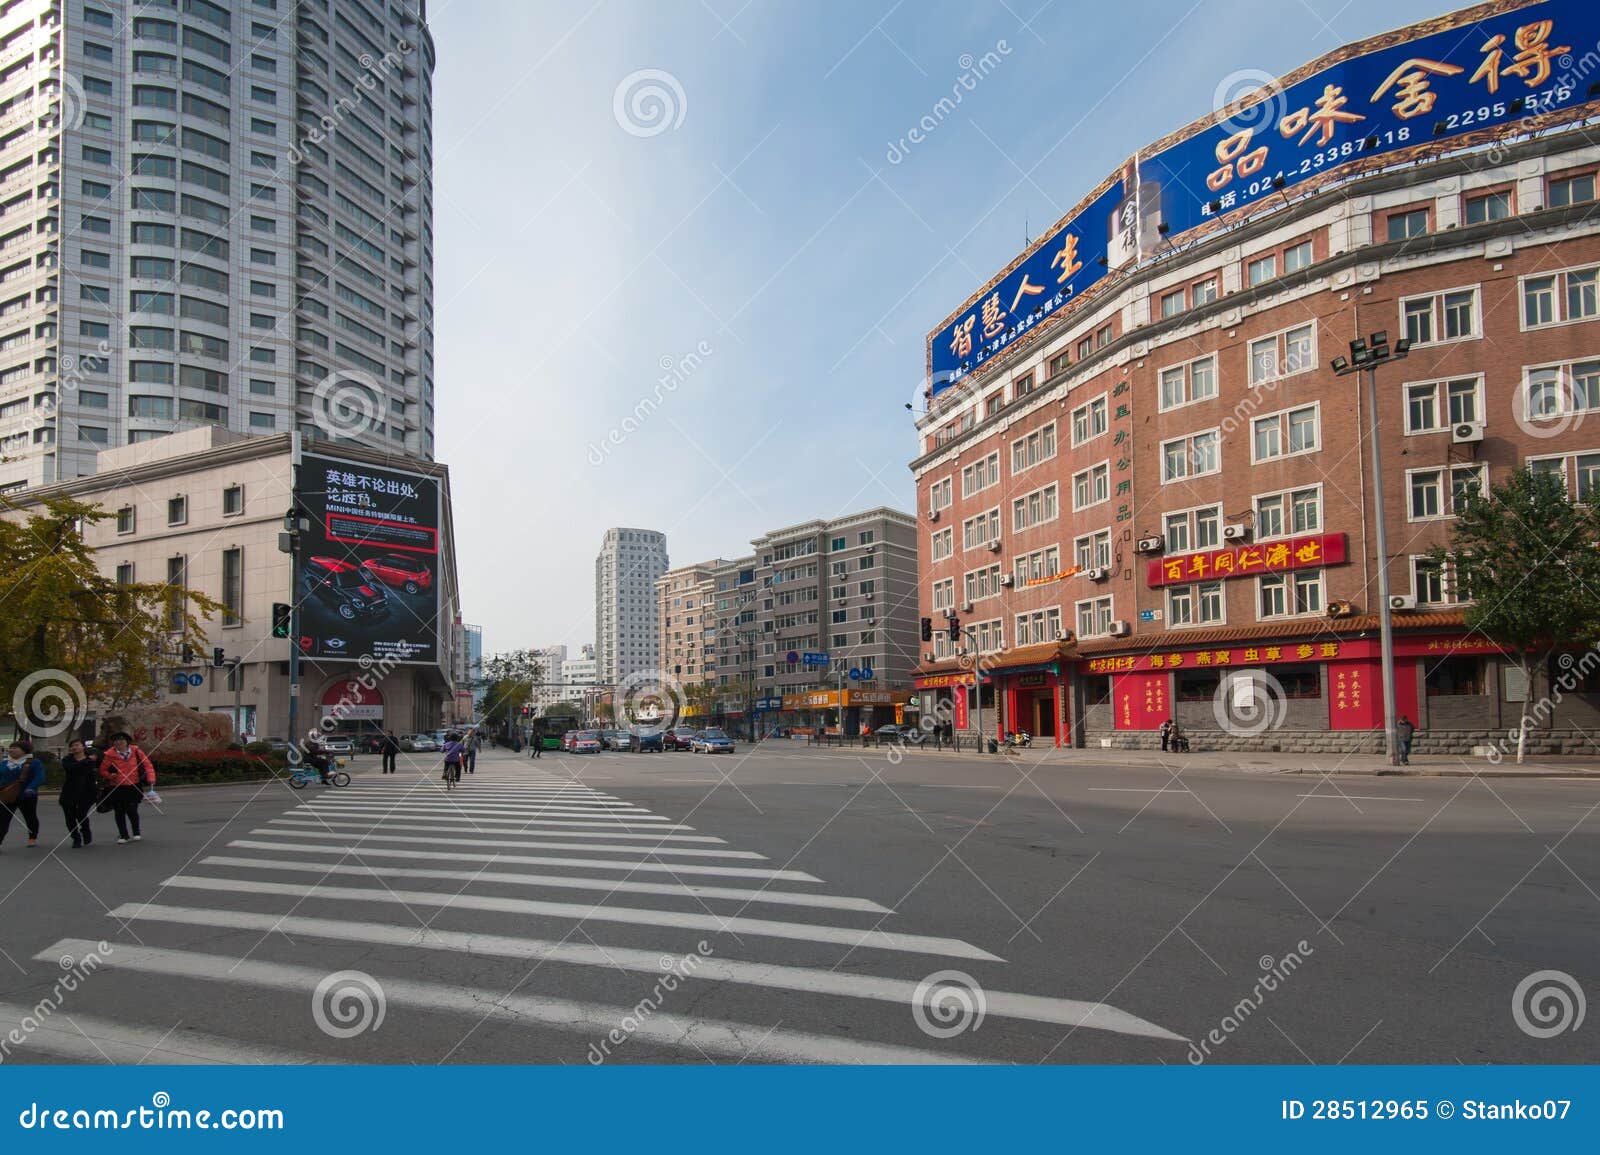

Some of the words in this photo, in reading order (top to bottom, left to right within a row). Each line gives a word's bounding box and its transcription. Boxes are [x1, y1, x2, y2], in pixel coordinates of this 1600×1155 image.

[1206, 19, 1571, 191] 品味舍得
[1446, 85, 1571, 130] 2295575
[950, 233, 1083, 359] 智慧人生
[1089, 656, 1135, 671] 北京同仁堂
[1196, 650, 1231, 665] 燕窝
[1244, 646, 1282, 662] 虫草
